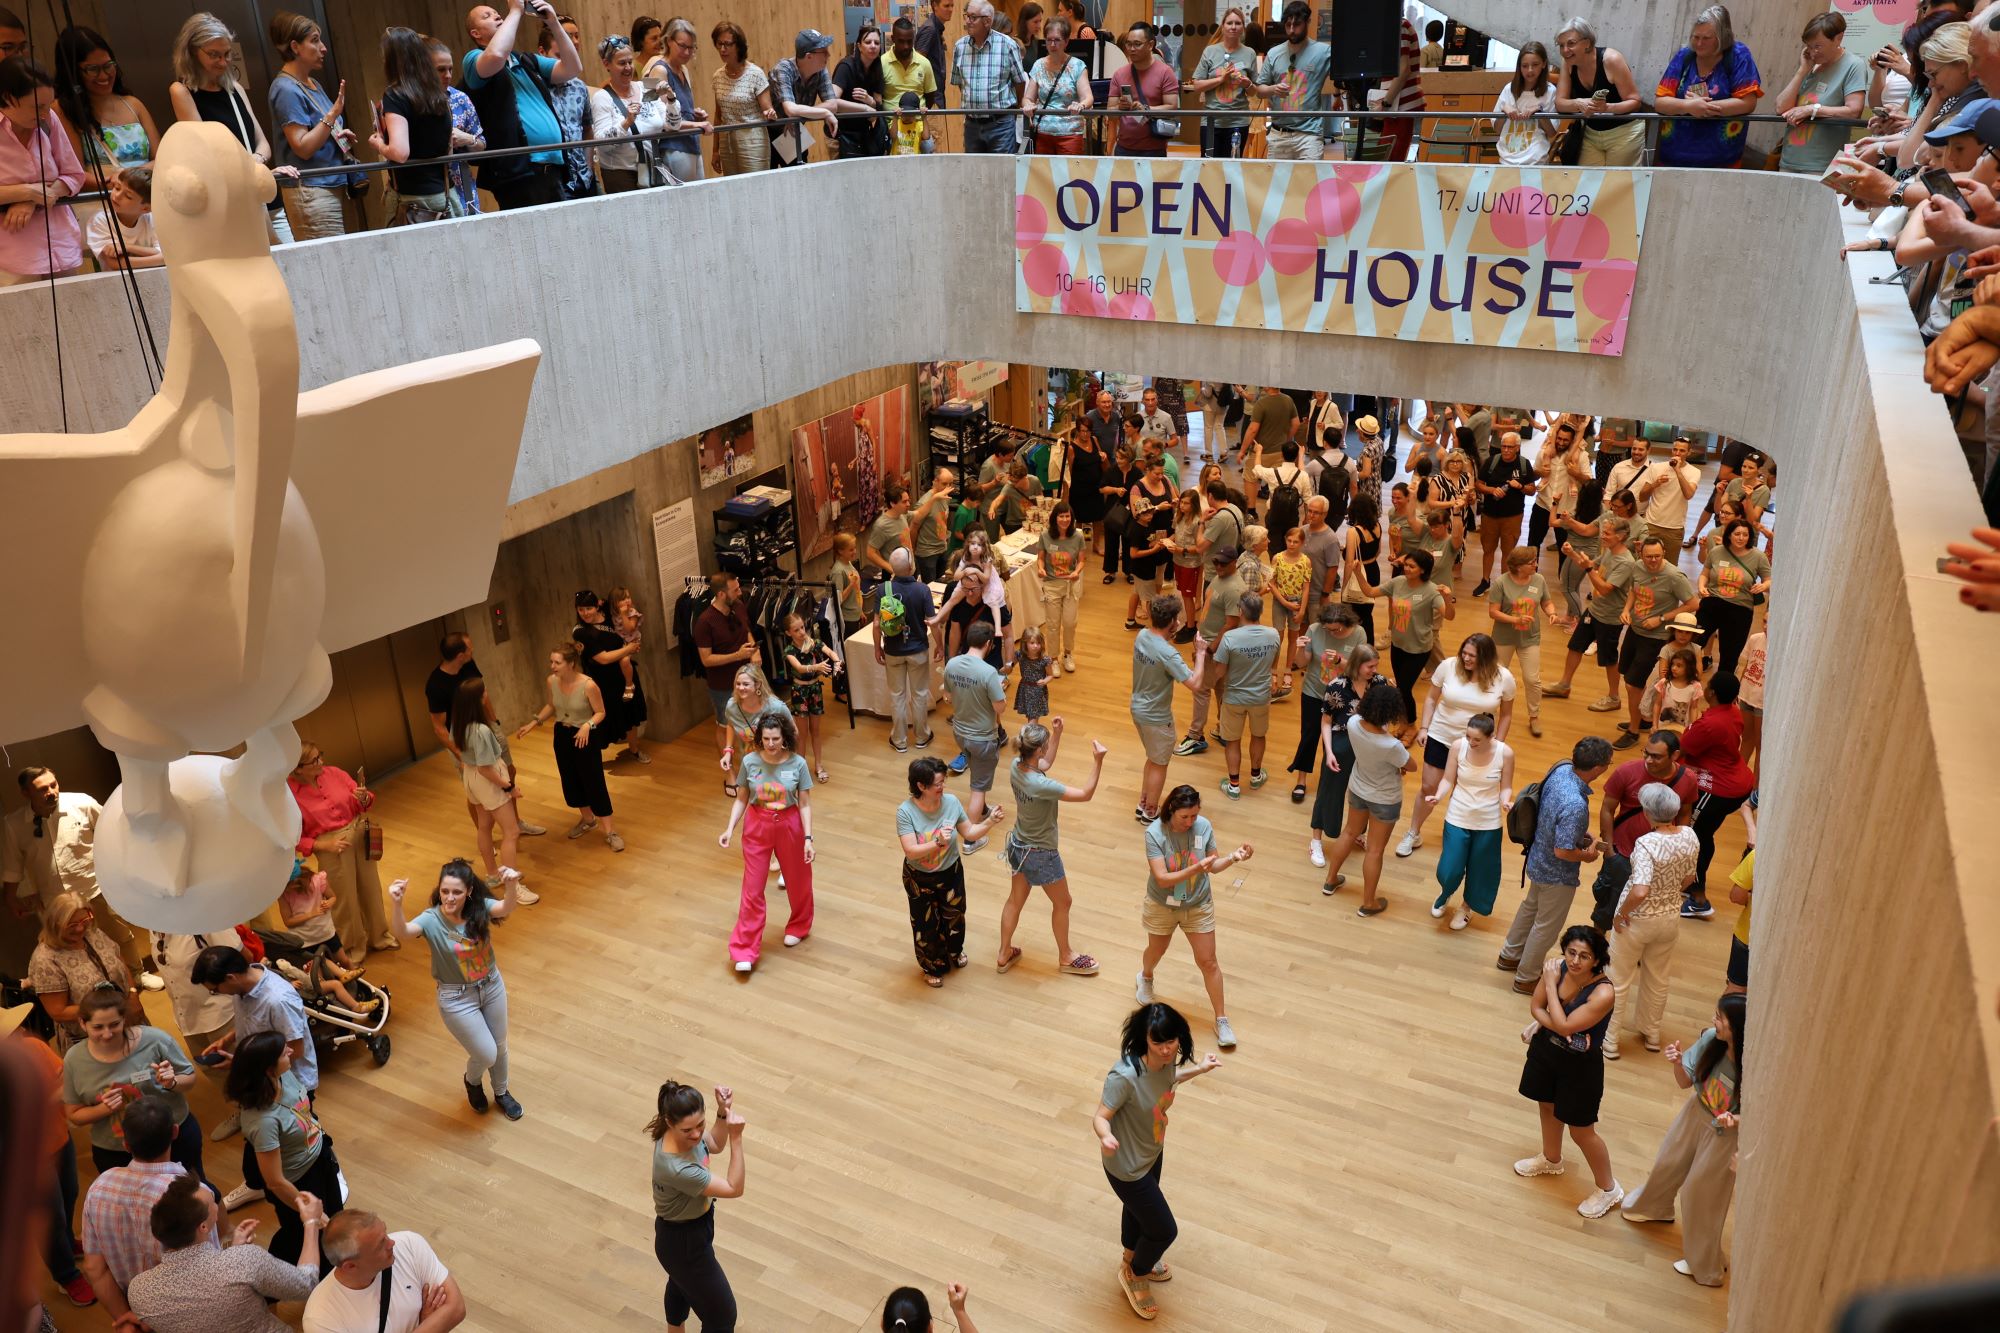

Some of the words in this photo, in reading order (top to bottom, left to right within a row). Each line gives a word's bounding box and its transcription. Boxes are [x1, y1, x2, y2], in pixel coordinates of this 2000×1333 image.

[1056, 178, 1232, 238] OPEN
[1436, 189, 1459, 212] 17.
[1466, 191, 1521, 214] JUNI
[1528, 193, 1590, 217] 2023
[1113, 276, 1152, 297] UHR
[1313, 248, 1583, 319] HOUSE
